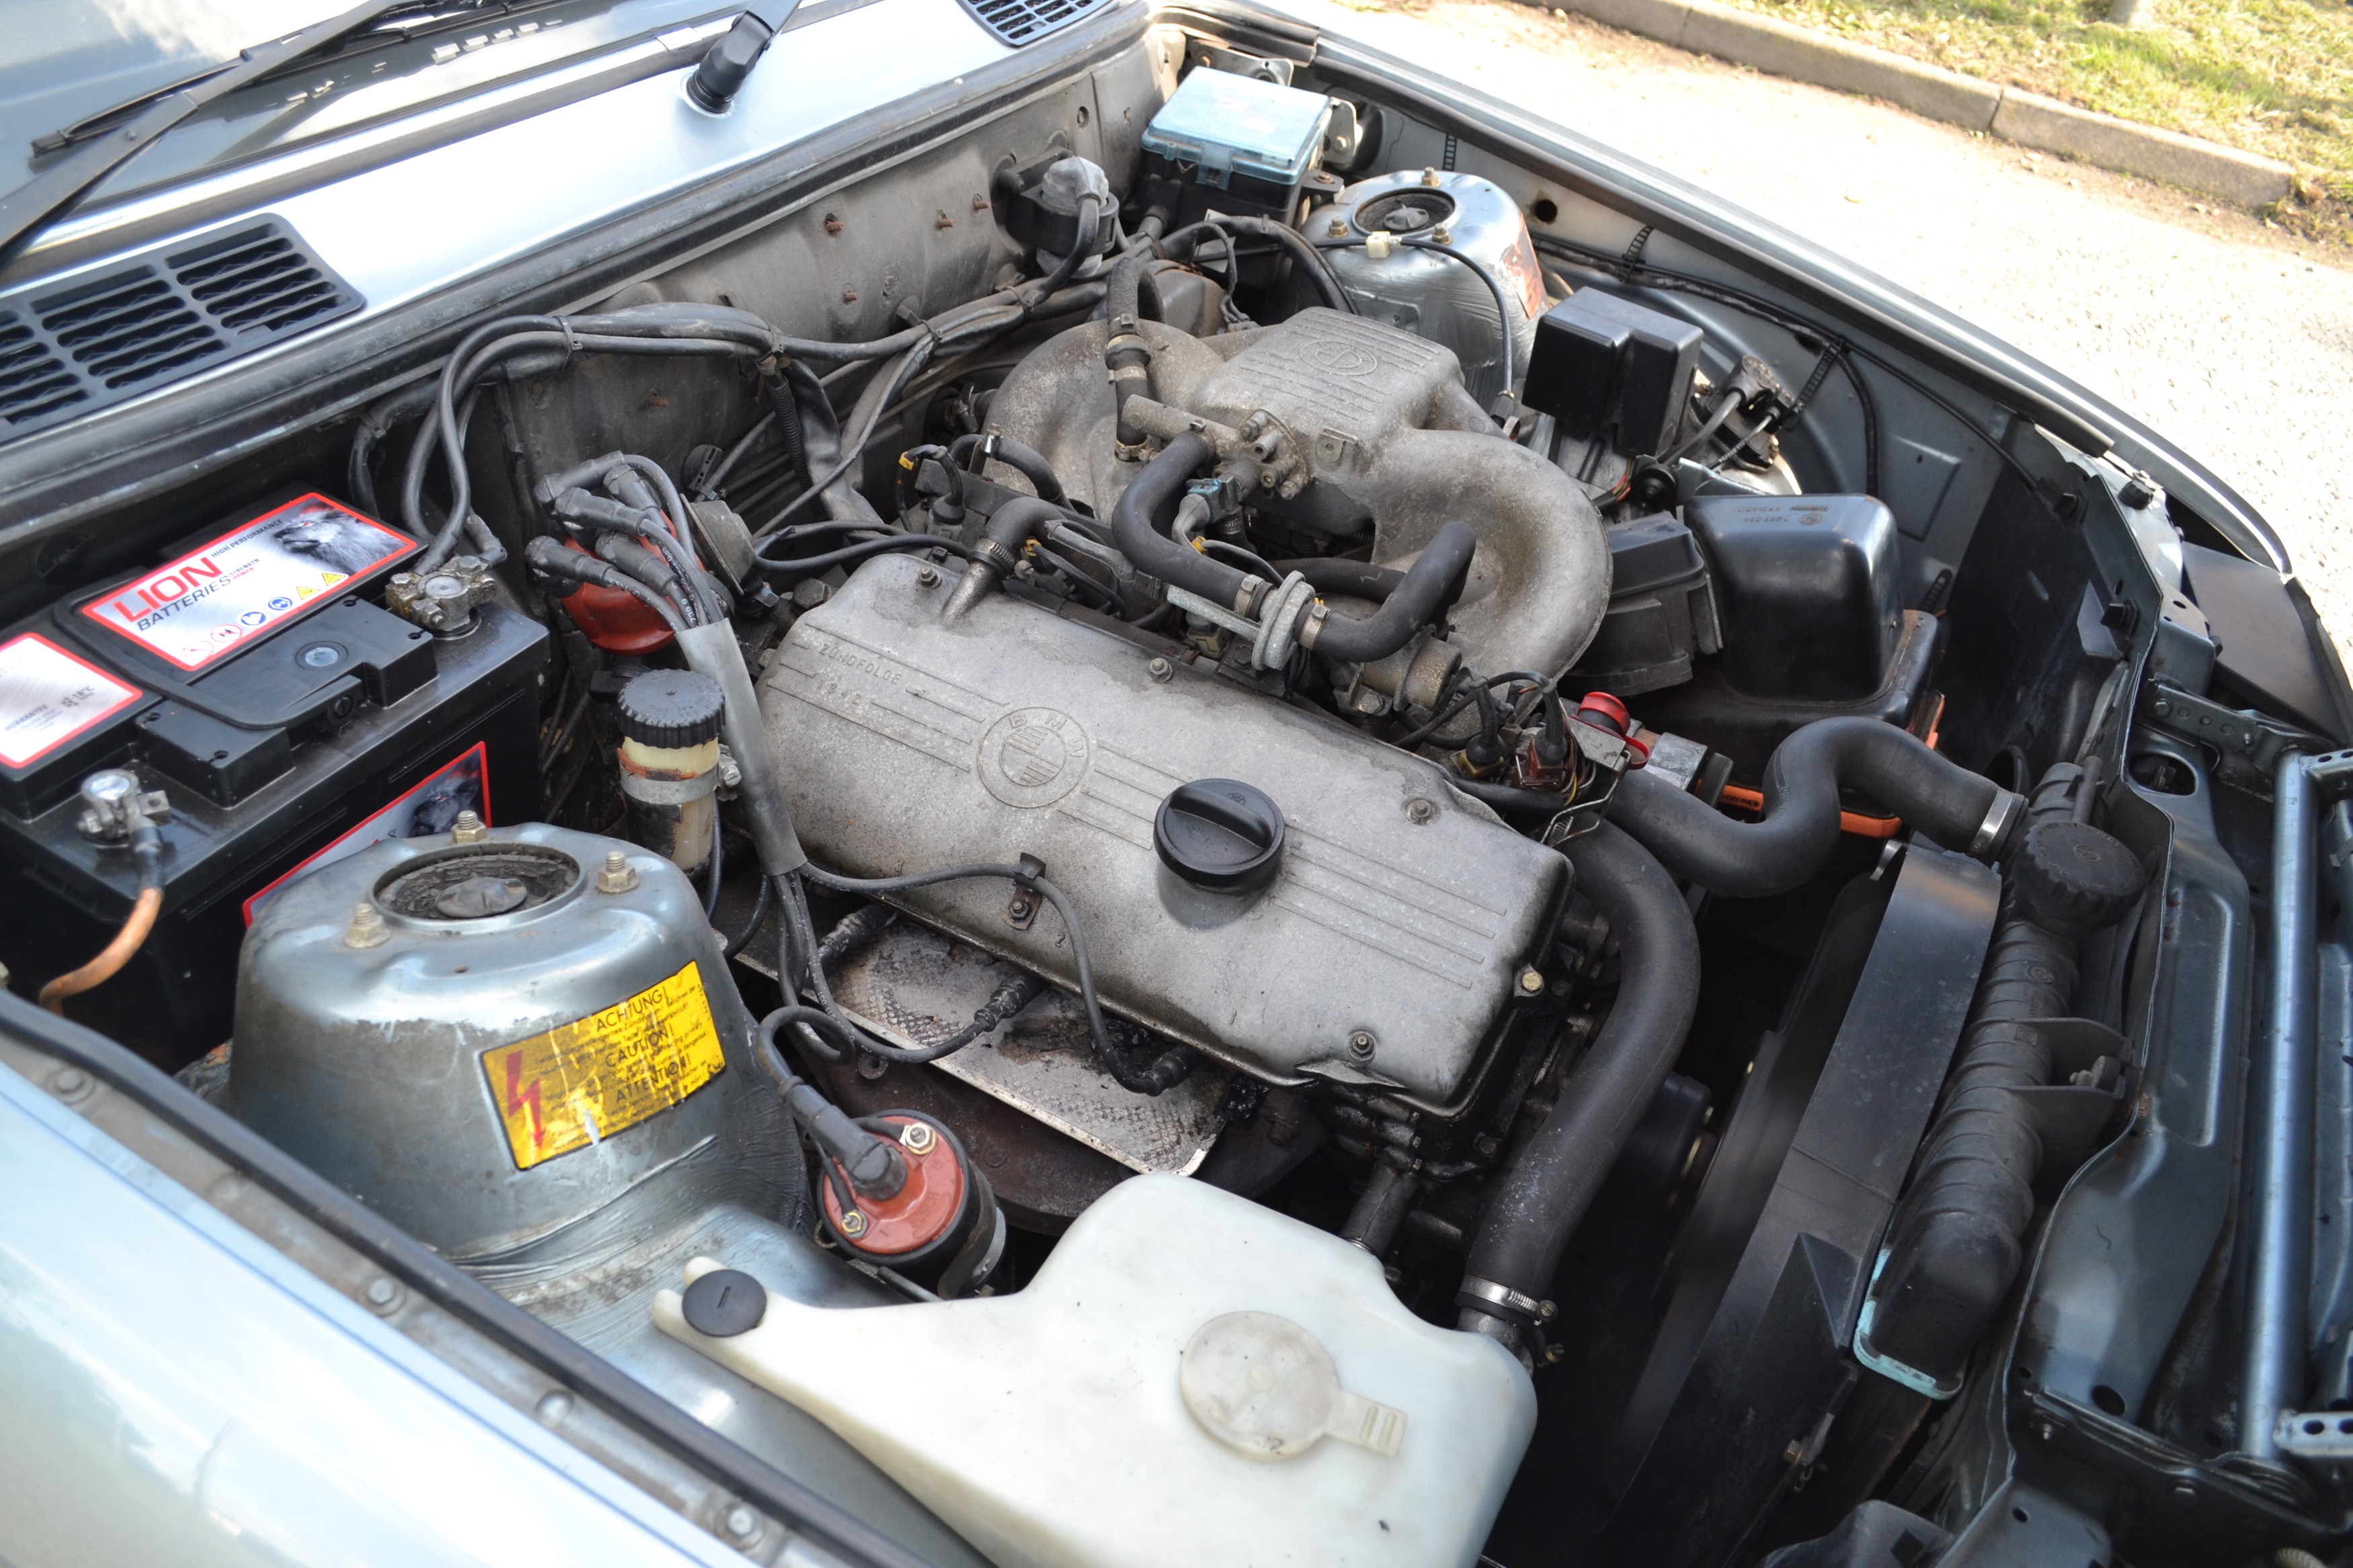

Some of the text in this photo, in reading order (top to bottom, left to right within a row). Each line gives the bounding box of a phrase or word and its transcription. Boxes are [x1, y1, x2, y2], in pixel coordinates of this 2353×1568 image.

[211, 518, 283, 559] HIGH PERFORMANCE
[113, 556, 223, 622] LION
[230, 559, 260, 577] STRENGTH
[137, 575, 231, 631] BATTERIES
[818, 643, 902, 685] ZÜNDFOLGE
[1008, 713, 1085, 758] BMW
[596, 986, 668, 1032] ACHTUNG!
[605, 1024, 674, 1067] CAUTION!
[616, 1053, 691, 1103] ATTENTION!
